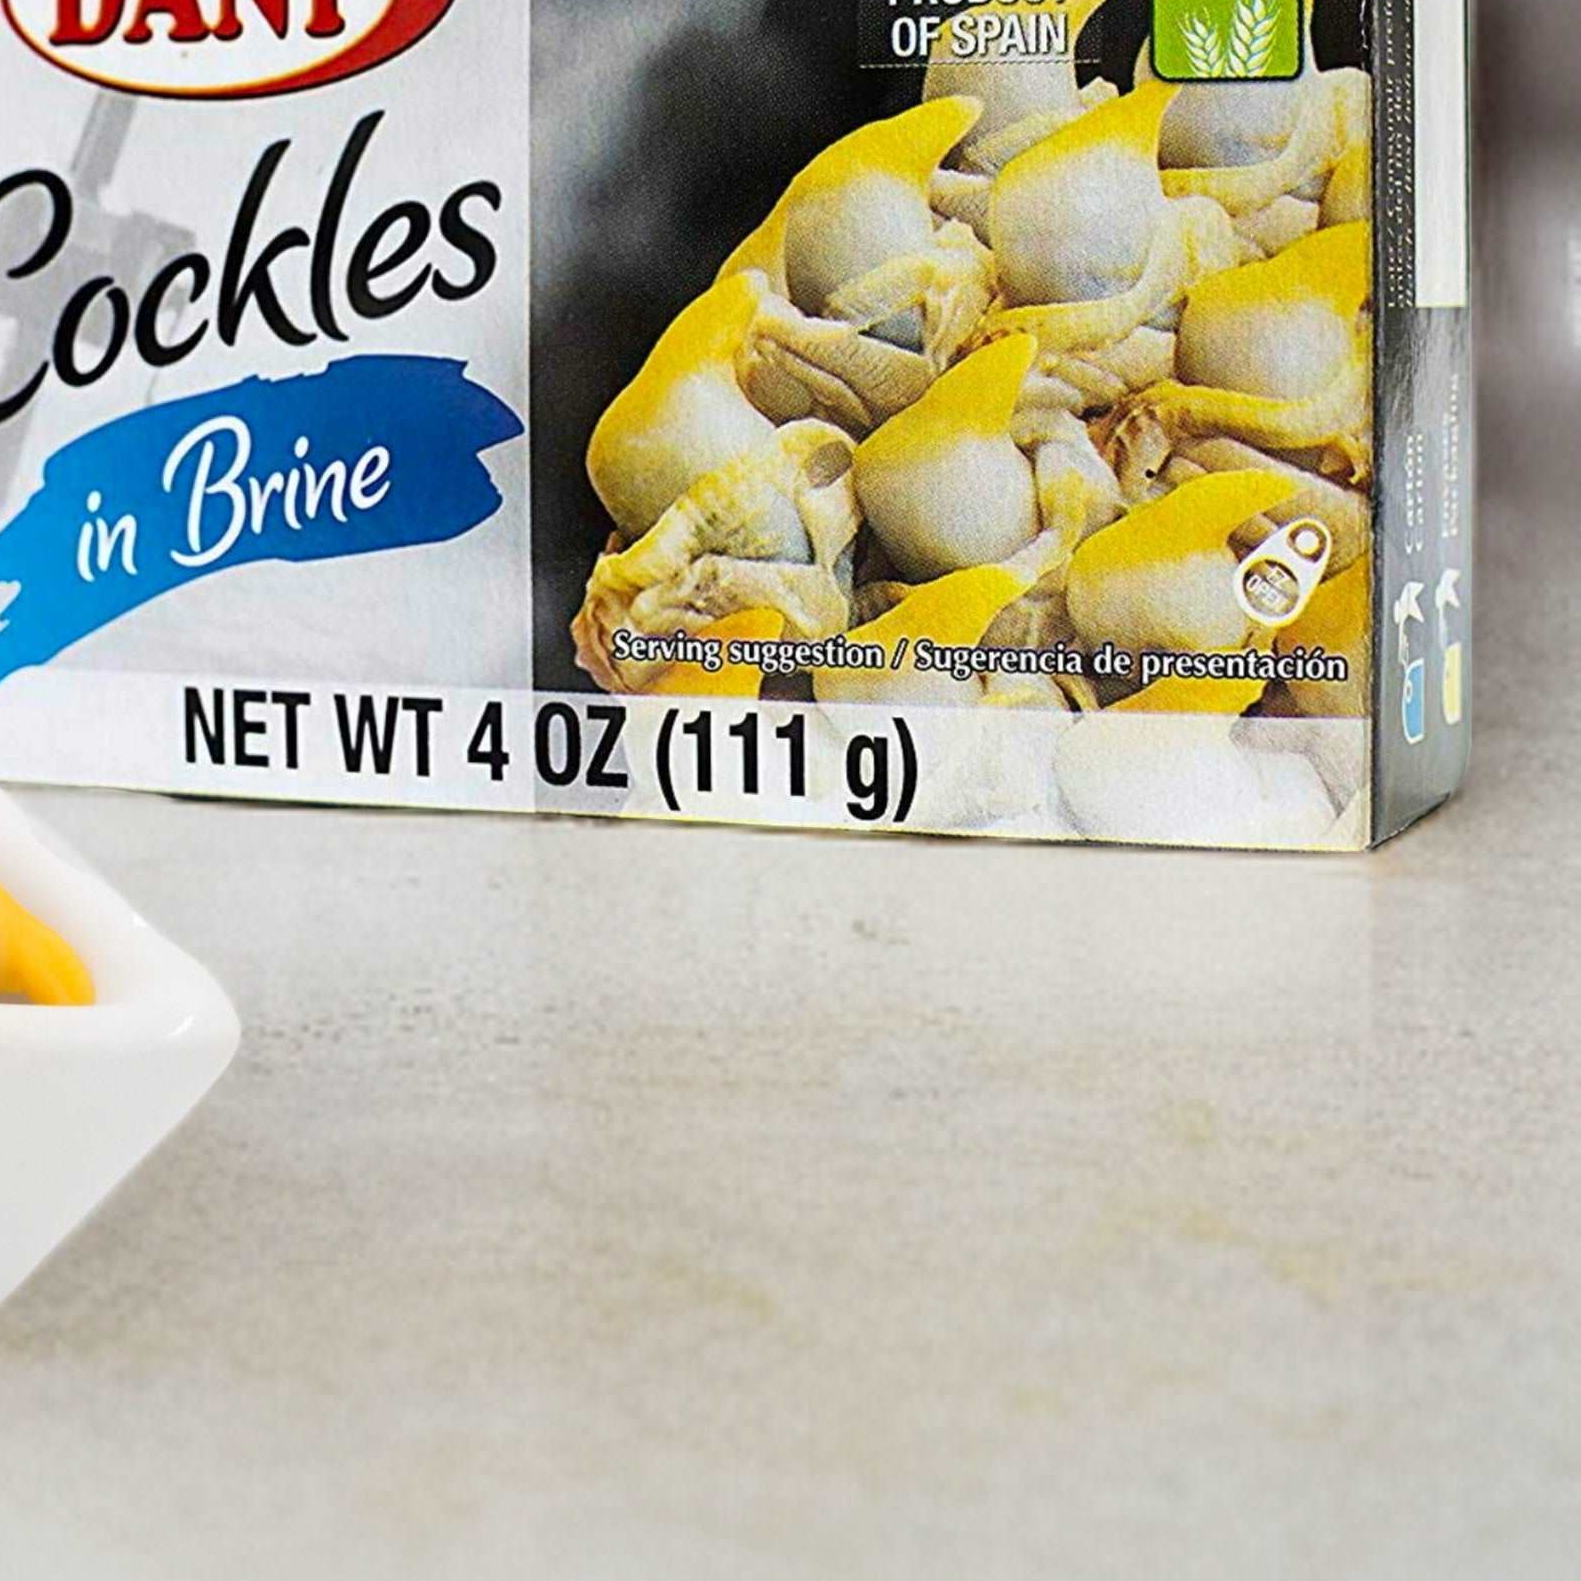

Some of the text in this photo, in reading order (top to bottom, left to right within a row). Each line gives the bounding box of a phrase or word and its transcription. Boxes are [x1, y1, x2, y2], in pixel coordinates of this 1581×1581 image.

[891, 13, 1067, 57] OF SPAIN
[77, 415, 390, 582] in Brine
[612, 628, 722, 672] Serving
[728, 633, 883, 674] suggestion
[915, 639, 1083, 680] Sugerencia
[1093, 643, 1132, 677] de
[1139, 647, 1348, 684] presentación
[183, 686, 918, 823] NET WT 4 OZ (111 g)
